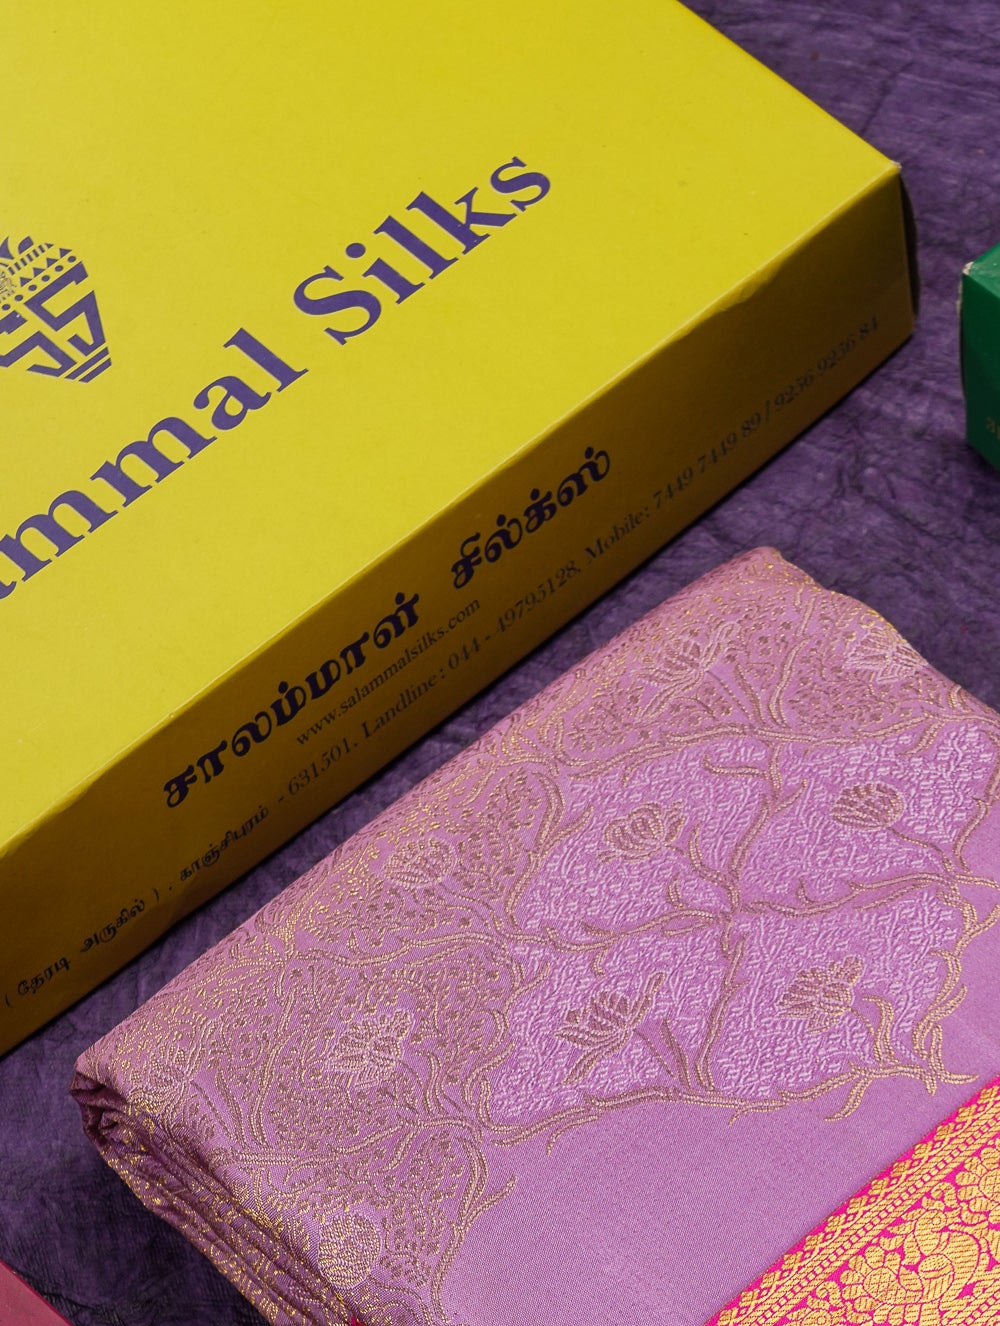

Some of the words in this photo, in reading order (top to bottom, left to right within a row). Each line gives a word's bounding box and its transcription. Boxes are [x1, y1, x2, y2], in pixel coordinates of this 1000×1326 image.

[292, 156, 552, 345] Silks
[164, 592, 419, 808] சாலம்மாள்
[451, 447, 610, 589] சில்க்ஸ்
[296, 600, 480, 745] www.salammalsilks.com
